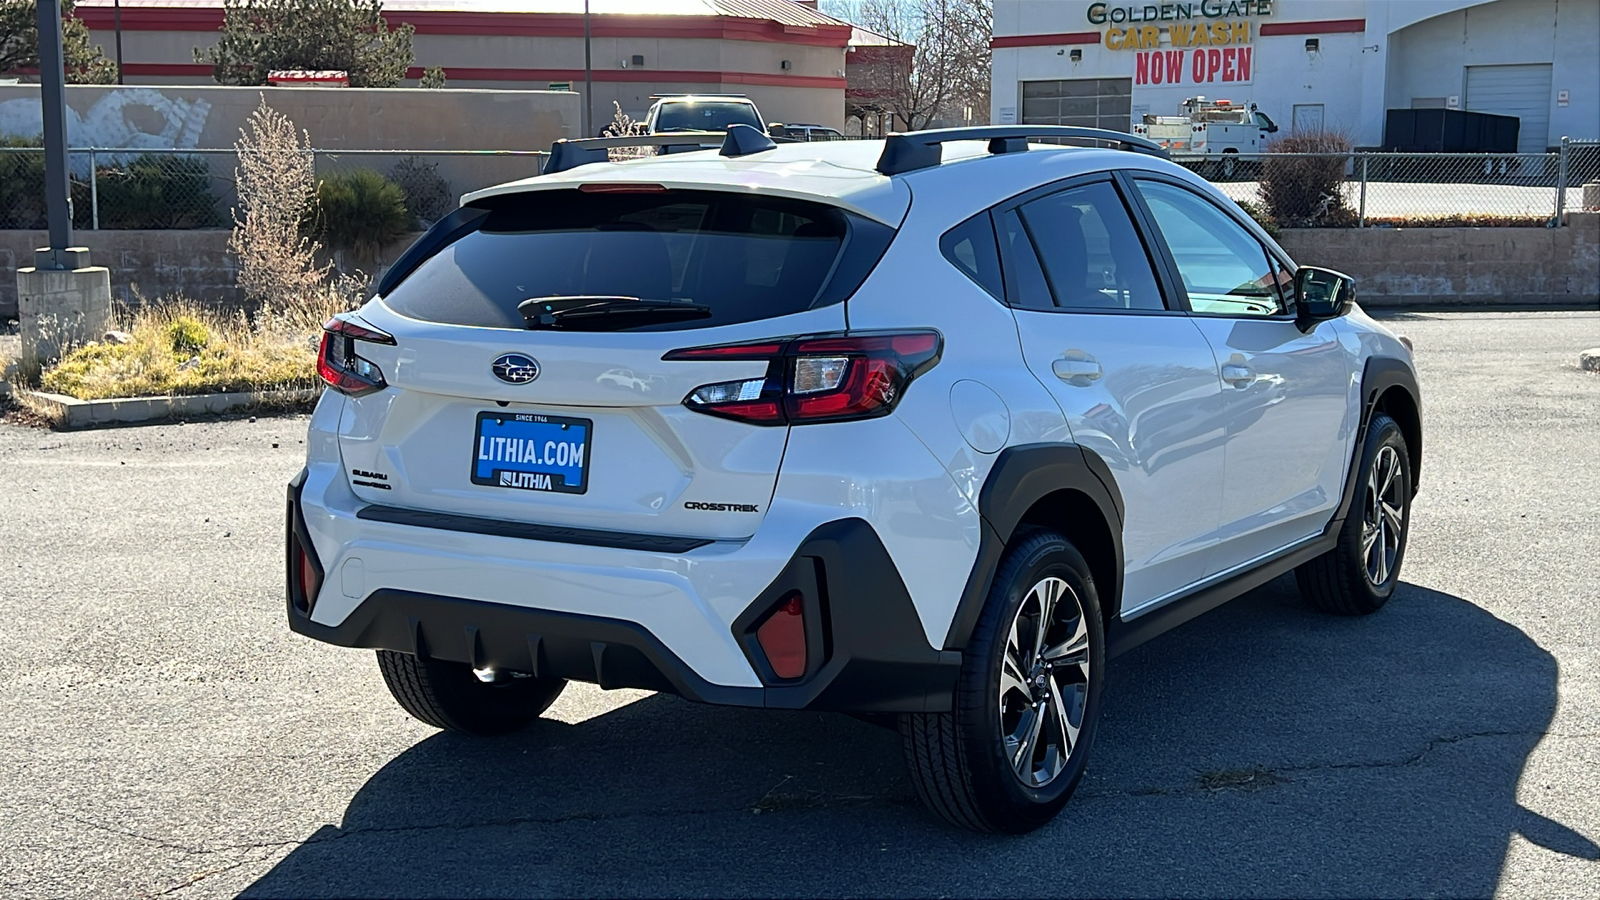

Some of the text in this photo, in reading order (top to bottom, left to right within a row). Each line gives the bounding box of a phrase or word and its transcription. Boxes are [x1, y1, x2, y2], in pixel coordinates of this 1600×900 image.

[1087, 2, 1192, 25] GOLDEN
[1105, 20, 1252, 51] CAR WASH
[1136, 47, 1252, 85] NOW OPEN
[515, 414, 548, 423] SINCE 1946
[479, 435, 585, 468] LITHIA.COM
[352, 468, 388, 480] SUBARU
[511, 471, 552, 490] LITHIA
[684, 501, 760, 513] CROSSTREK
